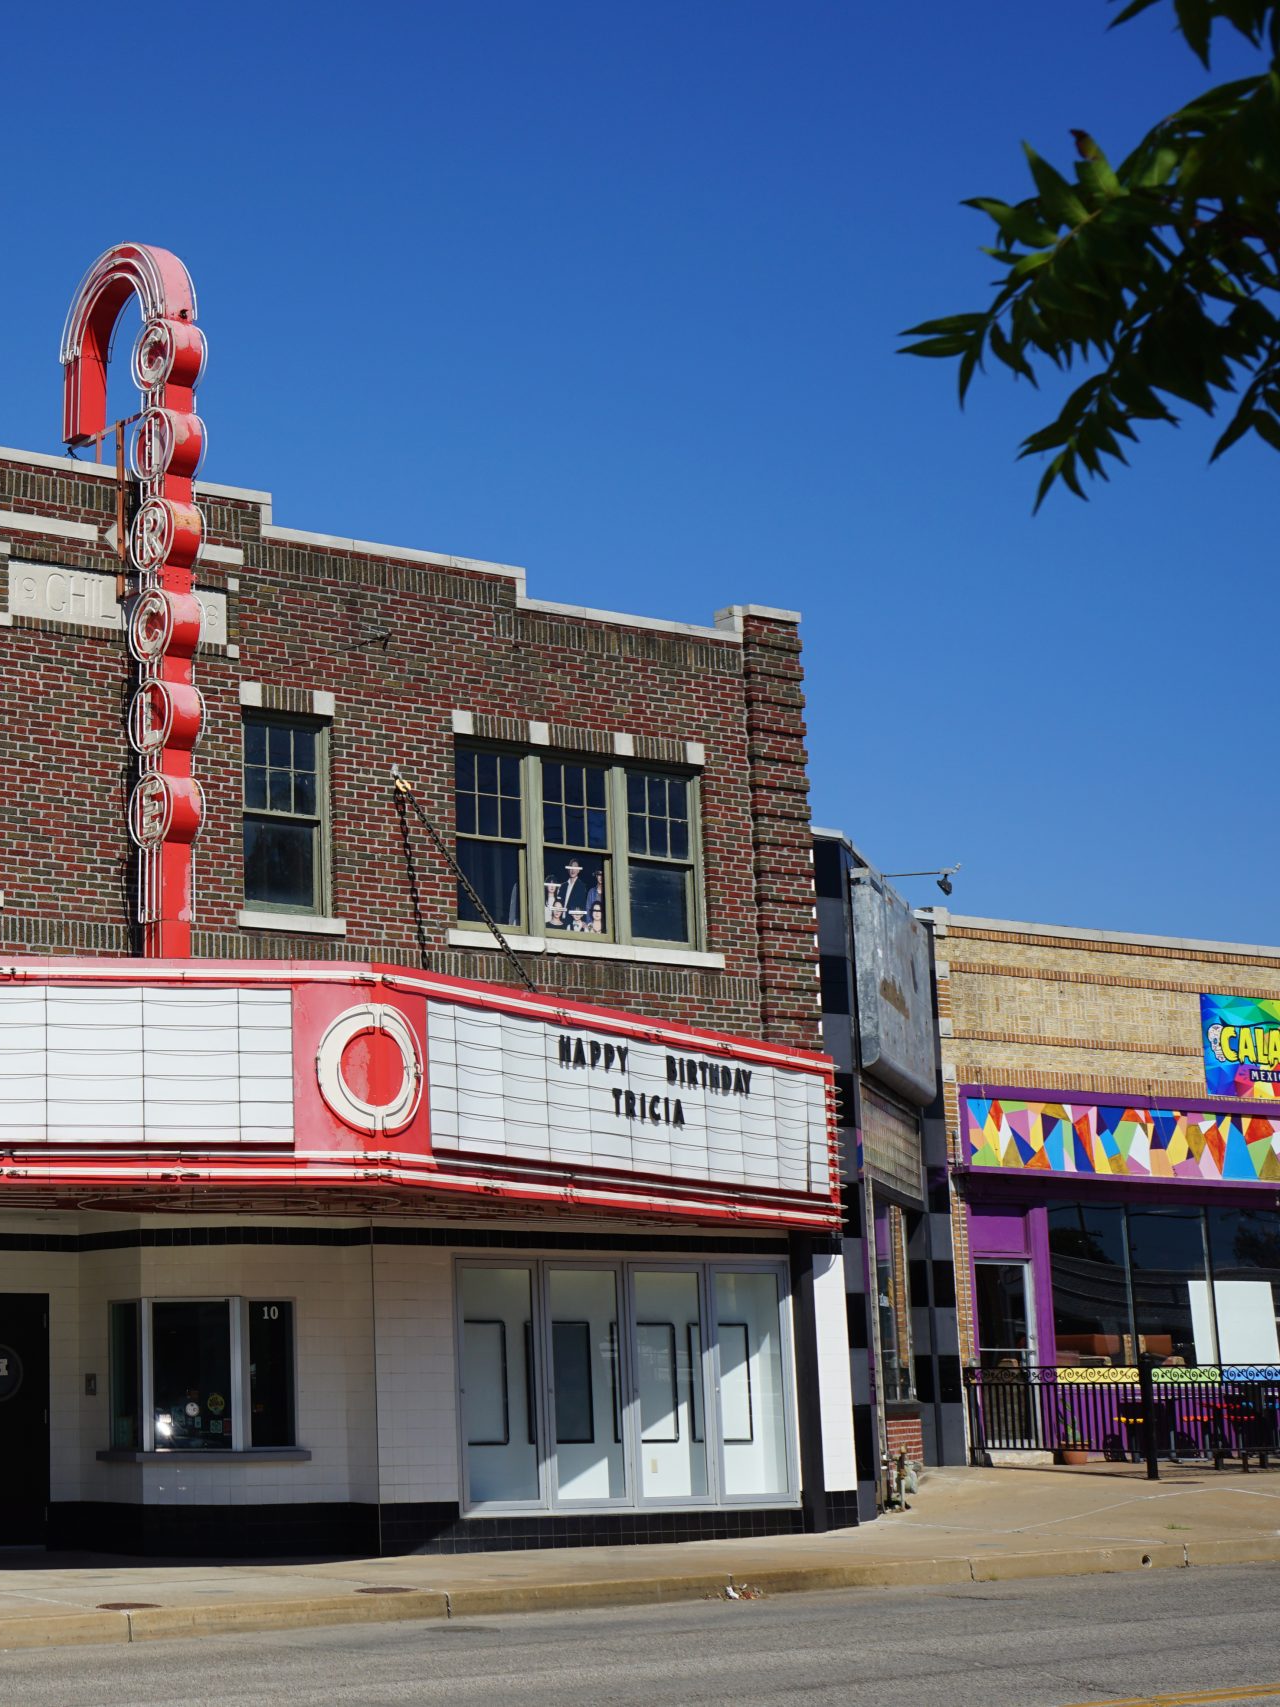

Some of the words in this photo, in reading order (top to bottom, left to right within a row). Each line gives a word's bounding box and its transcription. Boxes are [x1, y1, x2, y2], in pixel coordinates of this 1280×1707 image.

[132, 324, 168, 841] CIRCLE
[558, 1034, 629, 1073] HAPPY
[665, 1055, 753, 1095] BIRTHDAY
[1251, 1070, 1280, 1082] MEXI
[611, 1087, 686, 1125] TRICIA
[262, 1305, 279, 1320] 10
